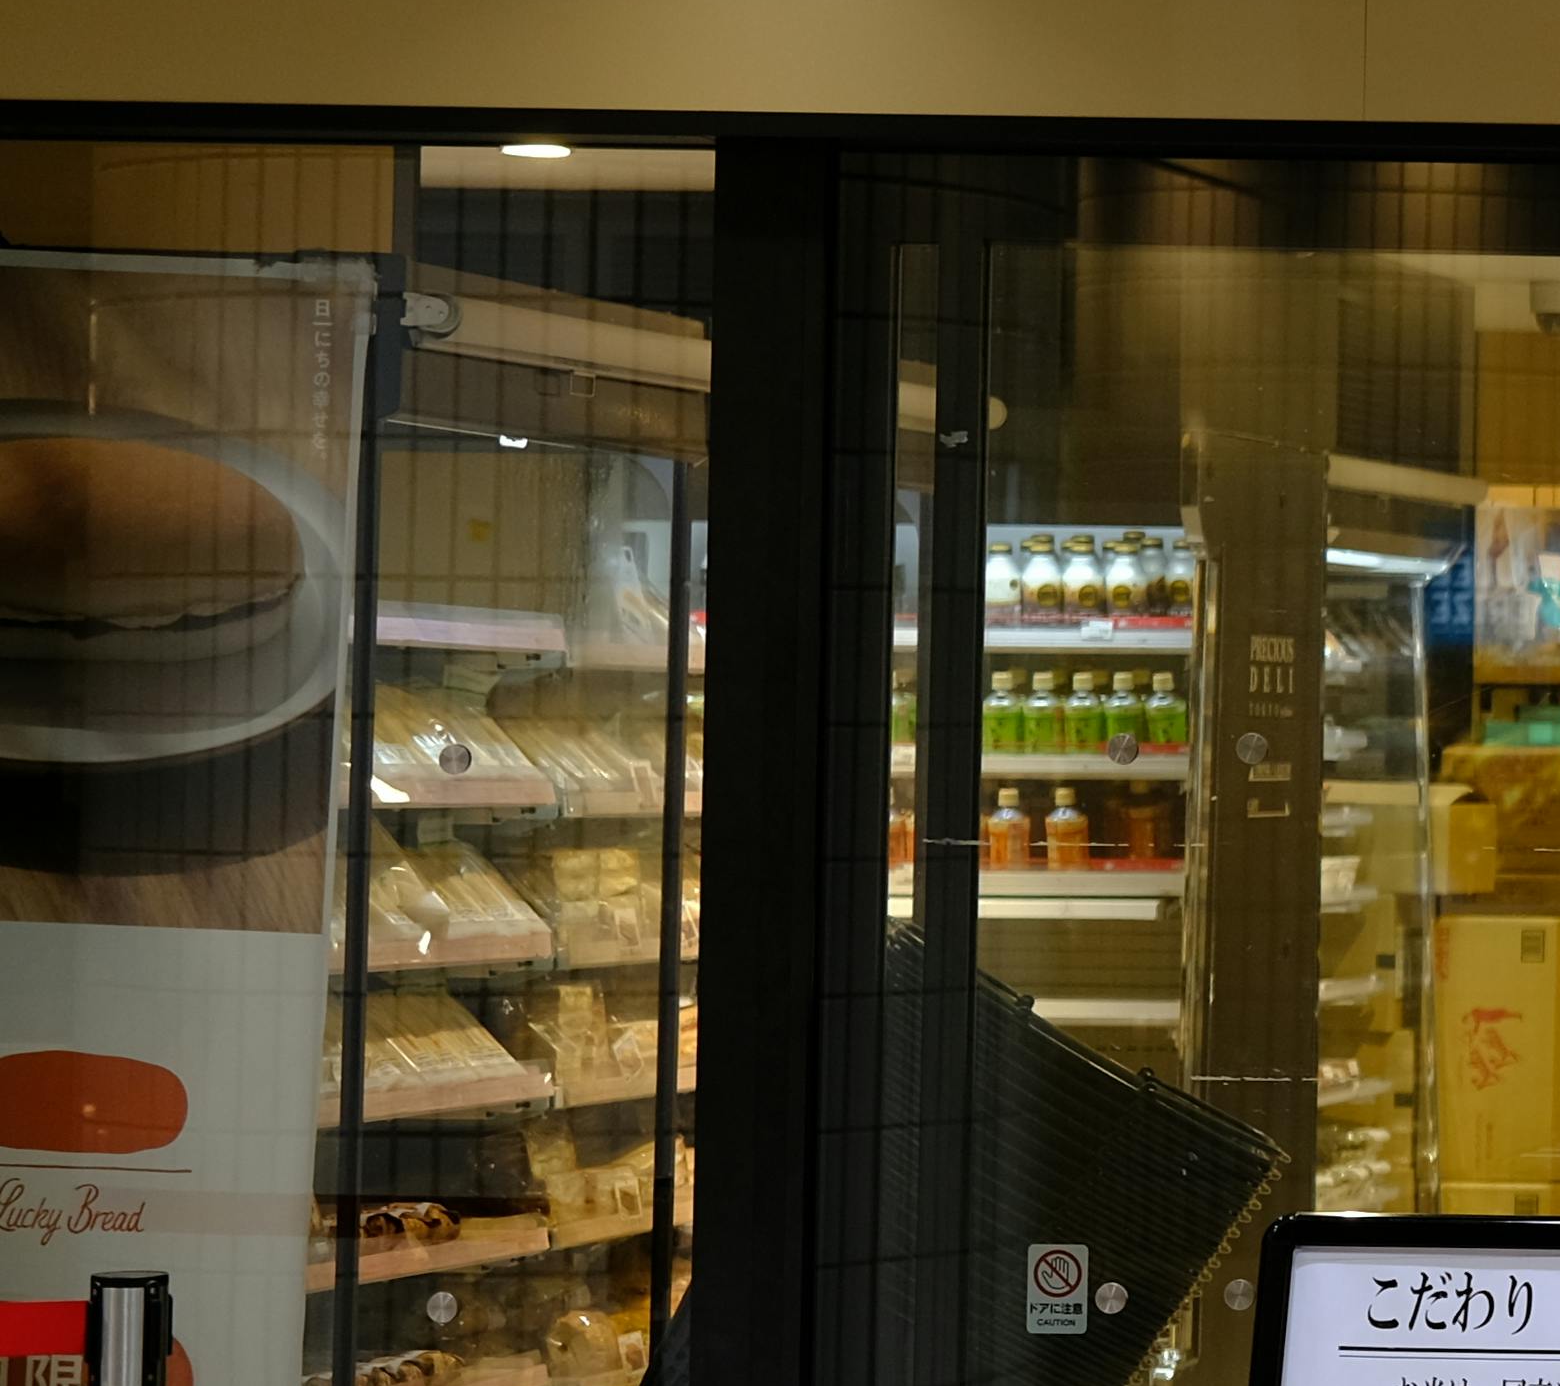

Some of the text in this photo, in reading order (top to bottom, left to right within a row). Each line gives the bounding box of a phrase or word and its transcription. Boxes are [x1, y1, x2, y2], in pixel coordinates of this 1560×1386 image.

[1250, 666, 1294, 694] DELI
[0, 1177, 145, 1246] Lucky Bread
[1030, 1303, 1083, 1315] ドアに注意
[1366, 1270, 1535, 1336] こだわり
